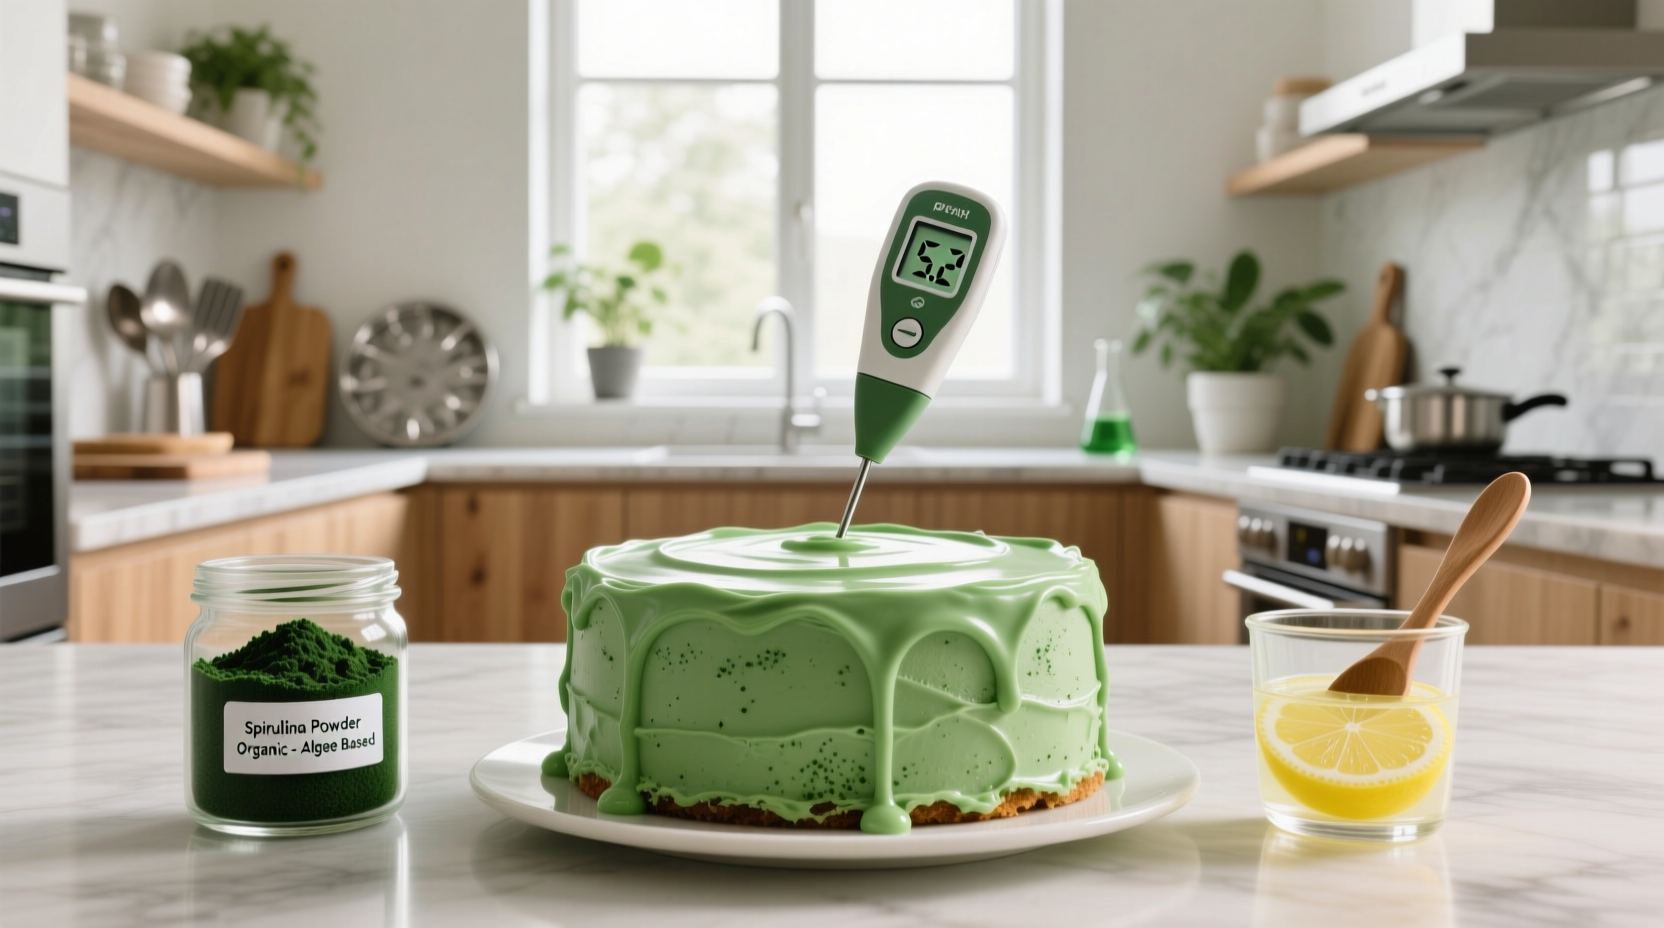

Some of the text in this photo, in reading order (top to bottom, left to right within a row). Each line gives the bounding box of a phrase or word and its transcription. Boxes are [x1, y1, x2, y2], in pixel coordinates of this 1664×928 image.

[912, 240, 966, 287] 5.2
[244, 716, 361, 739] Spirulina Powder
[237, 742, 288, 760] Organic
[300, 740, 338, 757] Algee
[341, 732, 376, 751] Based
